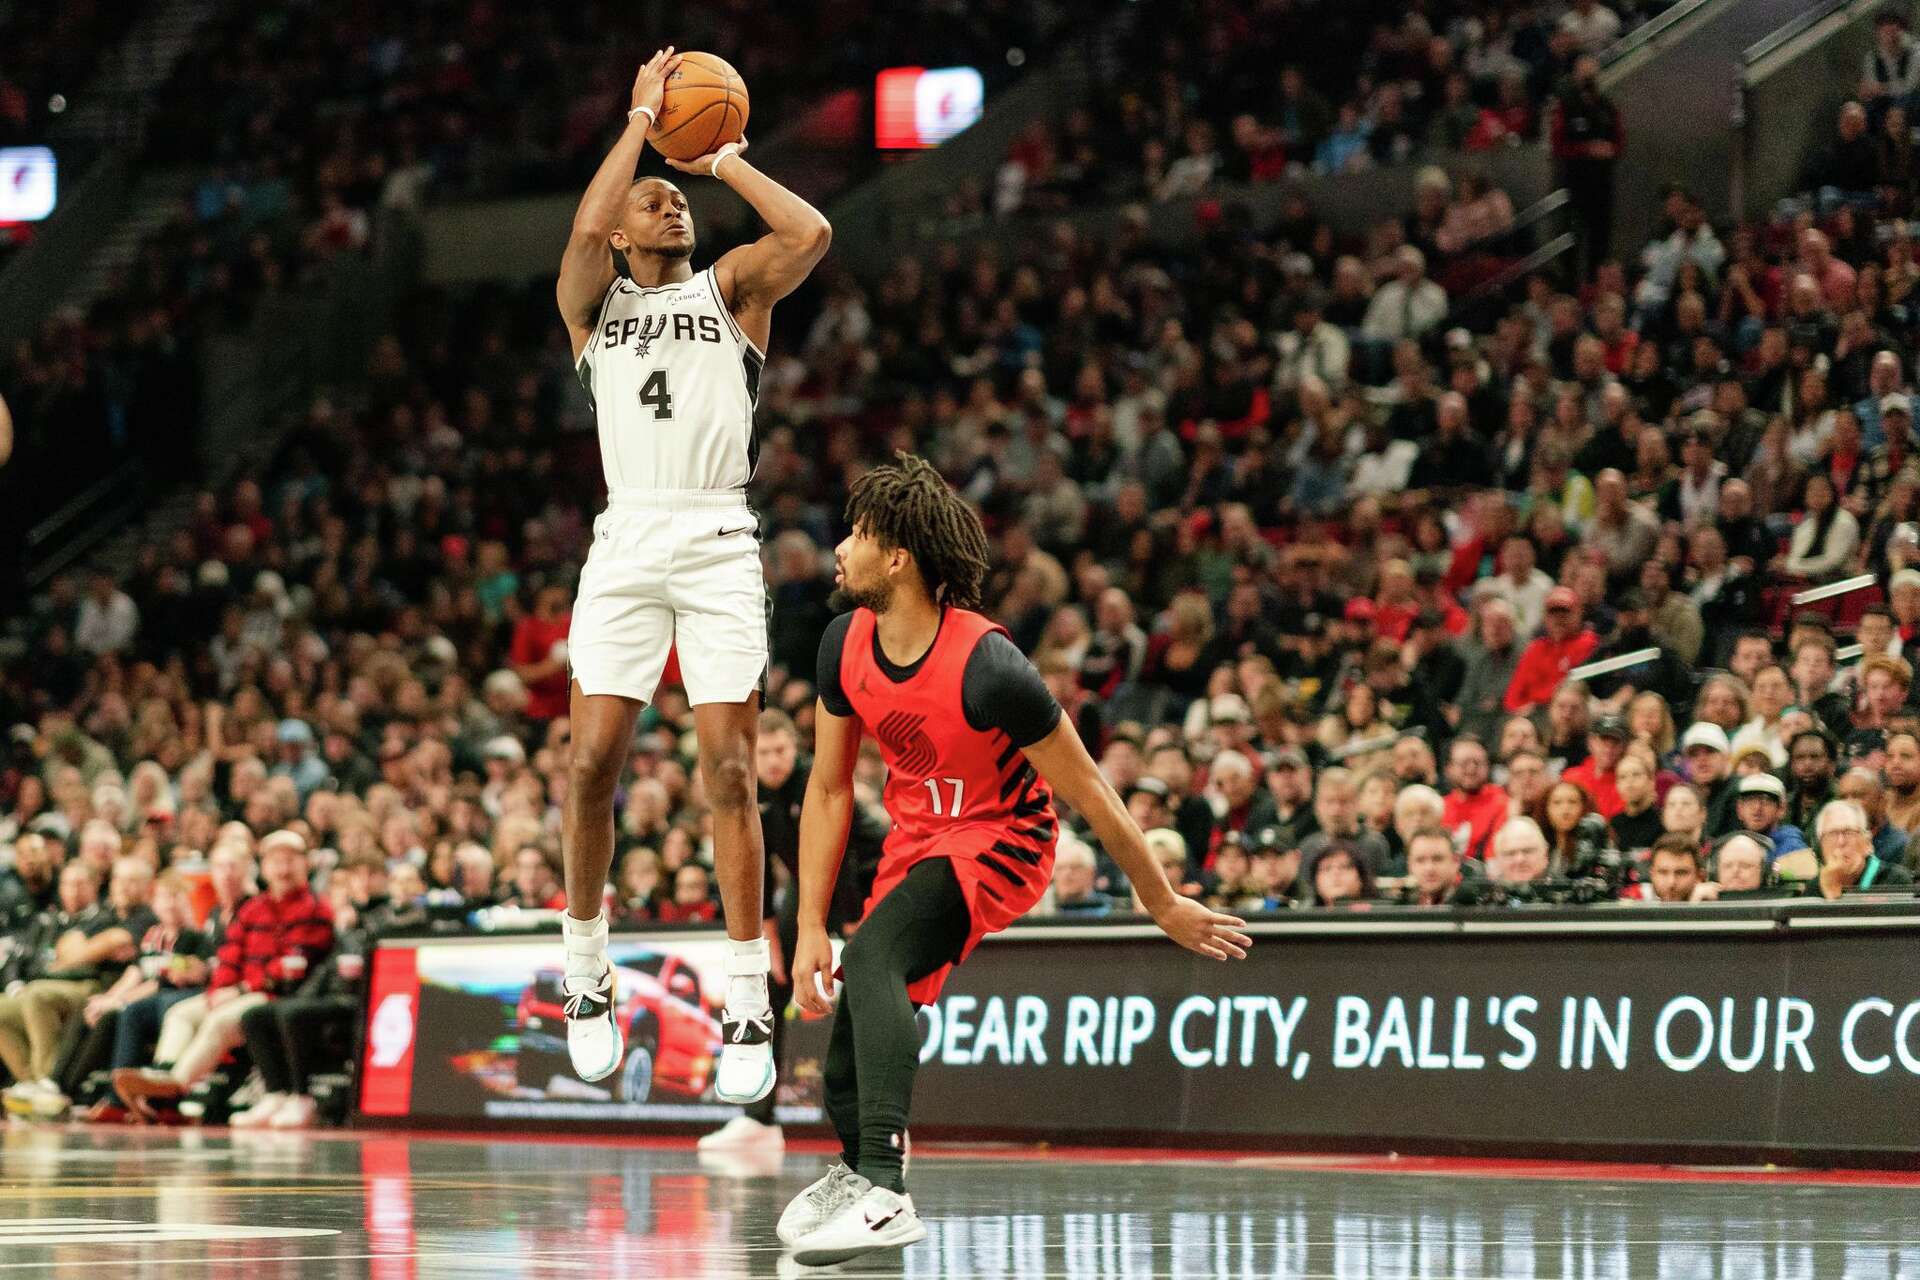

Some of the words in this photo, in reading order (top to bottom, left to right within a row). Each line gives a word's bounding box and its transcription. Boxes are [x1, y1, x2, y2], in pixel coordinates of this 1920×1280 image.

[604, 313, 722, 359] SPURS
[637, 367, 674, 421] 4
[923, 778, 964, 818] 17
[1063, 995, 1156, 1066] RIP
[1169, 995, 1311, 1080] CITY,
[1332, 995, 1539, 1071] BALL'S
[1559, 996, 1632, 1070] IN
[1654, 995, 1815, 1073] OUR
